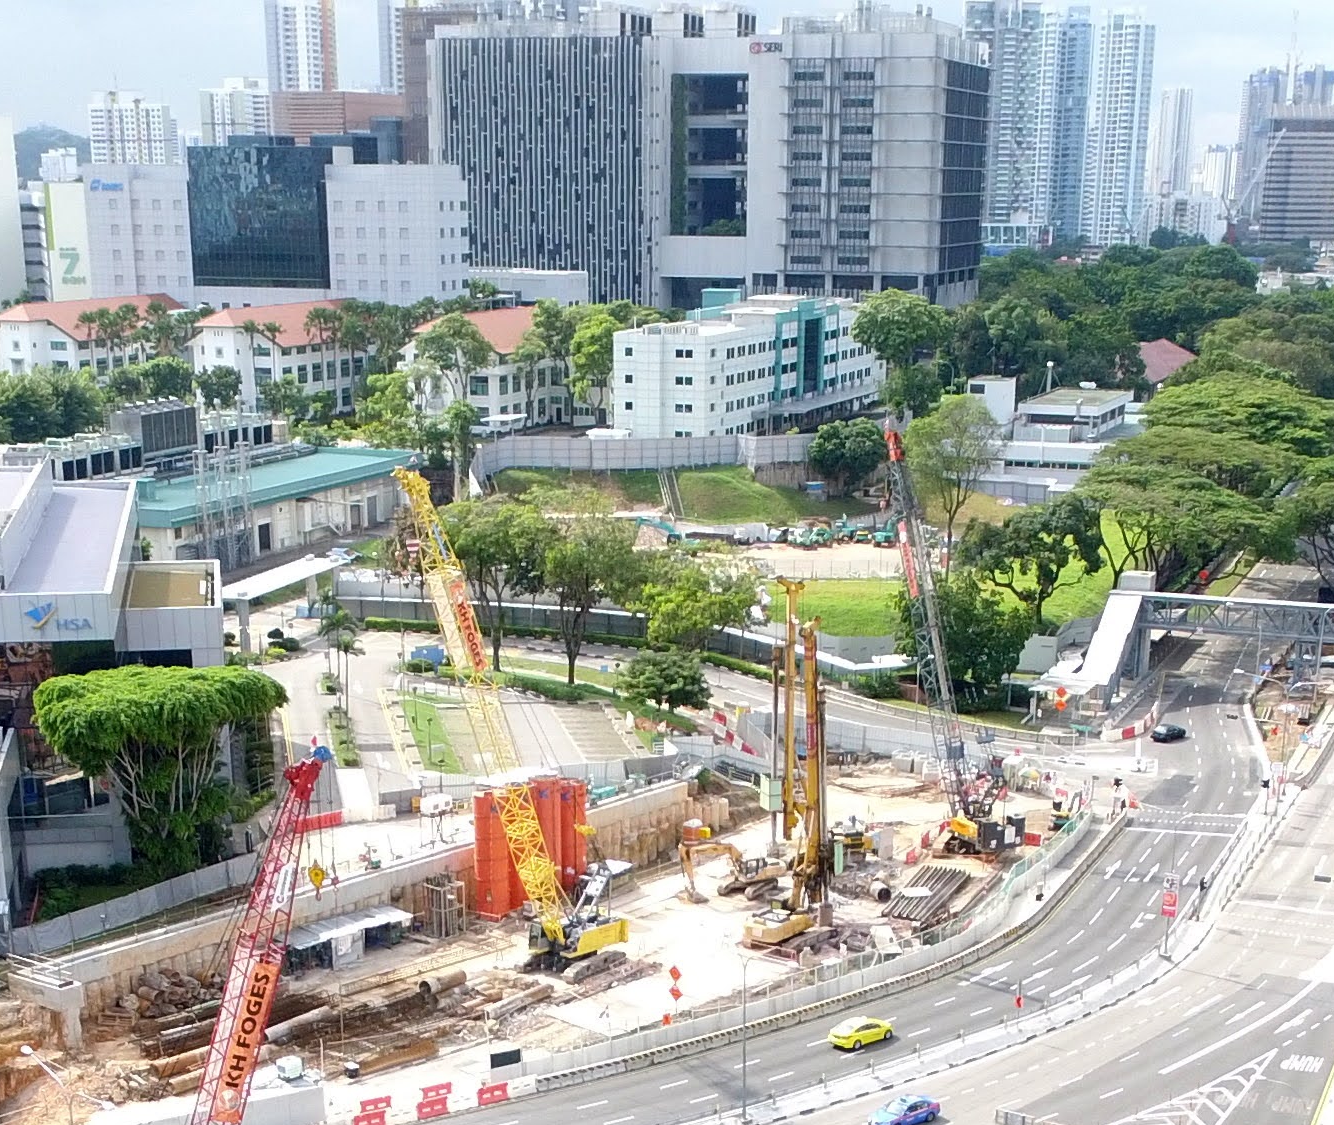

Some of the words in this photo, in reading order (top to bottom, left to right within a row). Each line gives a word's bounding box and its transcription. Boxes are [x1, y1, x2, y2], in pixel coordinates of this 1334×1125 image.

[763, 42, 783, 53] SERI
[59, 252, 80, 275] 7
[56, 618, 92, 632] HSA
[225, 1054, 247, 1088] KH
[237, 972, 270, 1049] FOGES
[1280, 1054, 1324, 1073] HUMP
